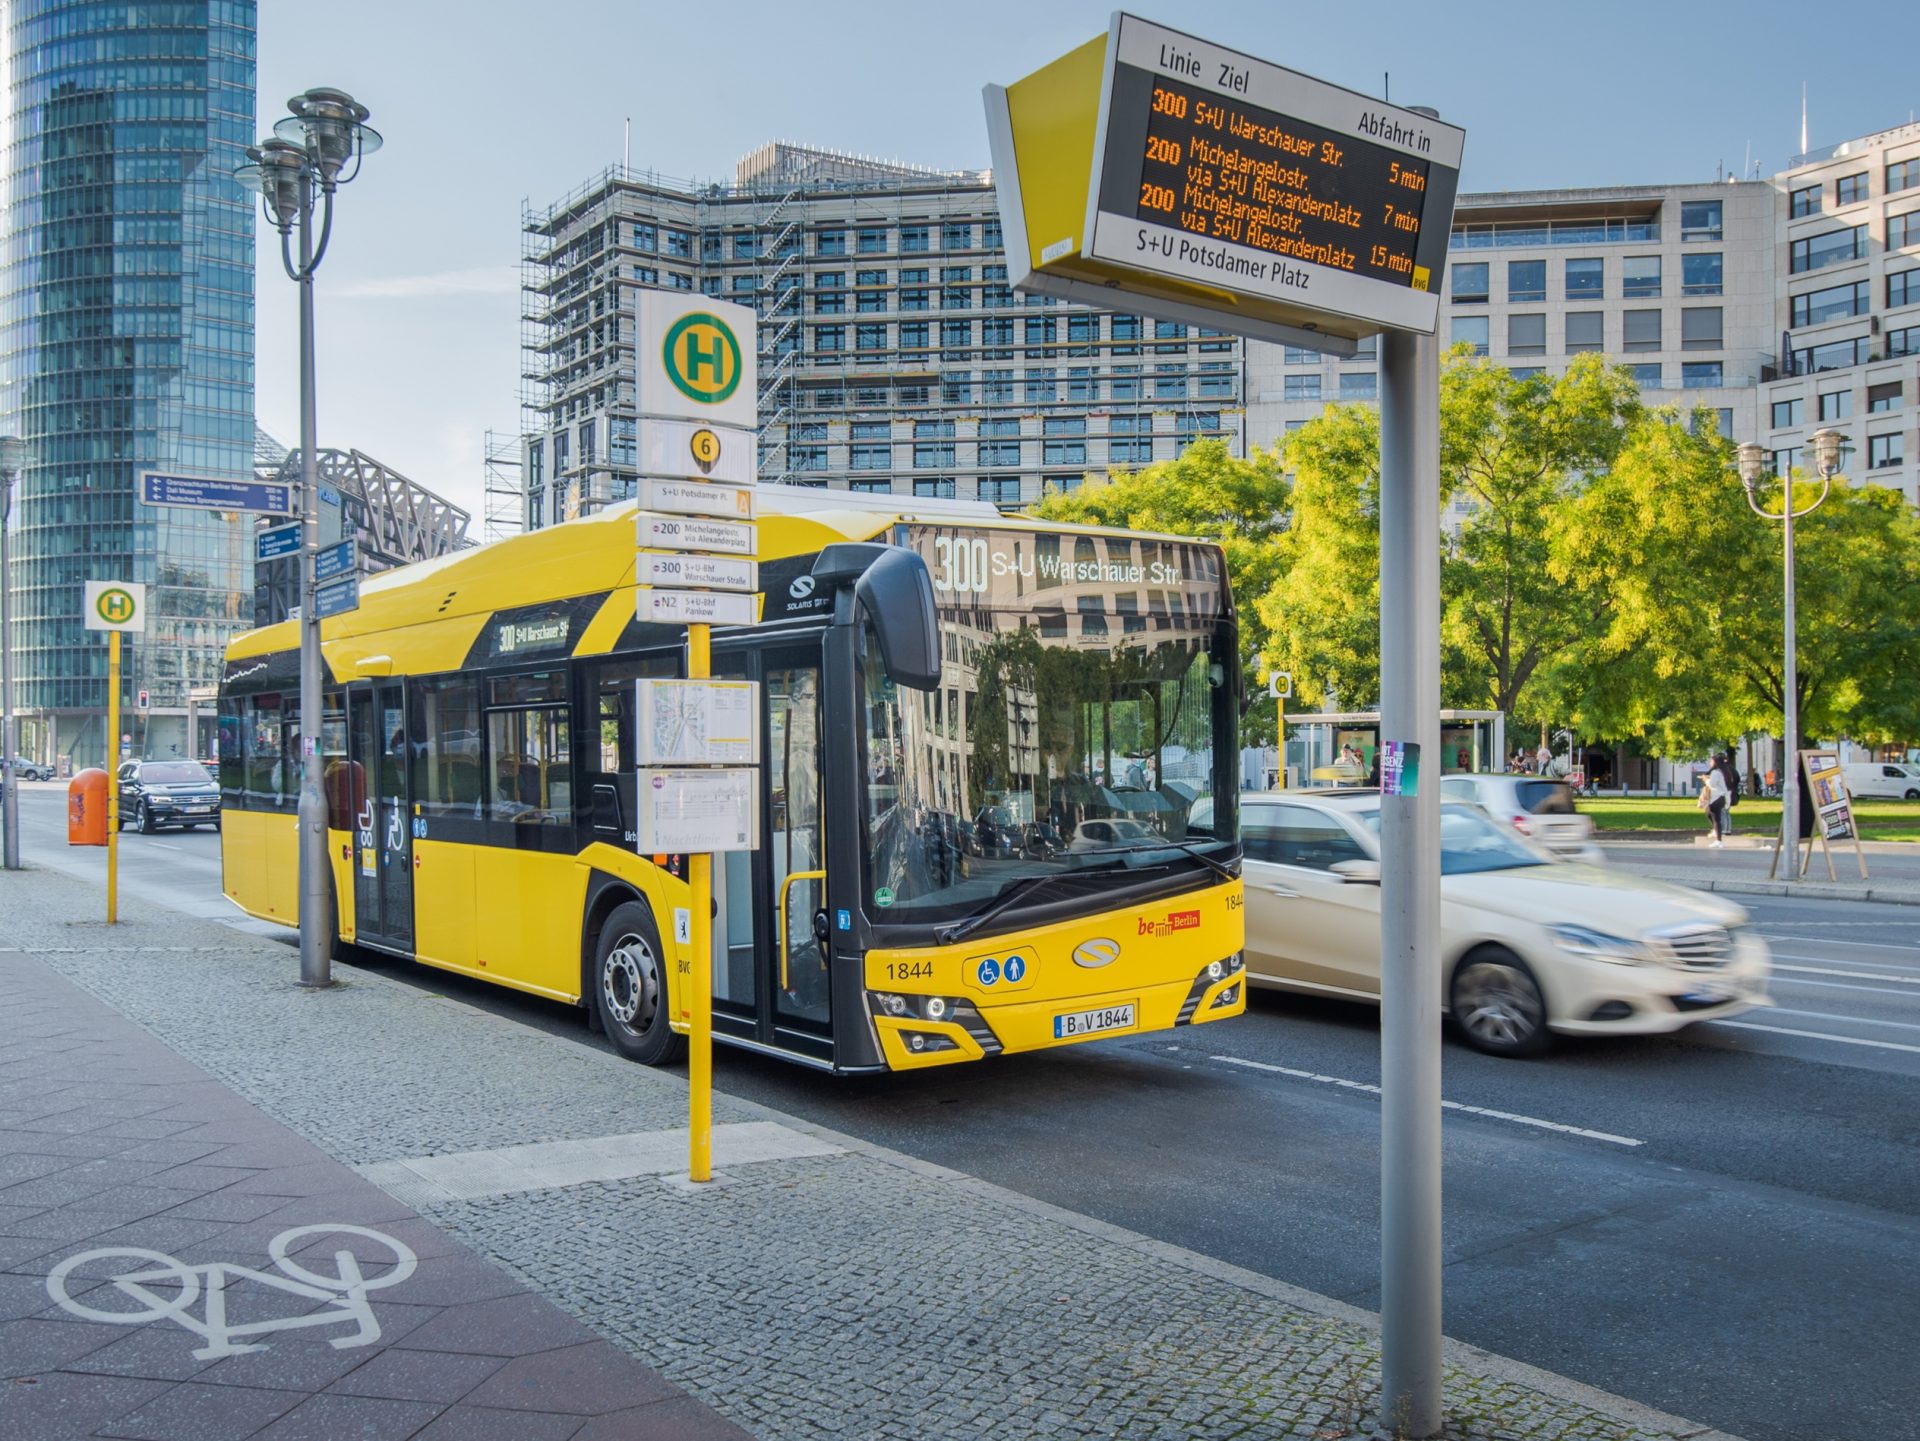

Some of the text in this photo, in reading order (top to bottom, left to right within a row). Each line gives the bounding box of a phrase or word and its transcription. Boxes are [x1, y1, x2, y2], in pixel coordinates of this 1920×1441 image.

[1160, 44, 1431, 153] Linie Ziel Abfahrt in
[1152, 88, 1426, 192] 300 S+U Warschauer Str. 5 min
[1146, 136, 1420, 233] 200 Michelangelostr. 7 min
[1187, 163, 1362, 228] via S+U Alexanderplatz
[1140, 183, 1413, 275] 200 Michelangelostr. 15 min
[1180, 209, 1356, 270] via S+U Alexanderplatz
[1136, 228, 1310, 290] S+U Potsdamer Platz
[1413, 277, 1427, 290] BVG
[687, 332, 724, 385] H
[701, 438, 711, 455] 6
[681, 488, 719, 500] Potsdamer
[660, 523, 681, 535] 200
[698, 534, 746, 548] Alexanderplatz
[661, 562, 681, 574] 300
[934, 536, 1182, 593] 300 S+U Warschauer Str.
[684, 572, 746, 586] Warschauer Straße
[106, 597, 126, 617] H
[661, 596, 677, 608] N2
[685, 606, 714, 616] Pankow
[786, 600, 812, 610] SOLARIS
[499, 624, 515, 652] 300
[528, 624, 560, 642] Warschauer
[1138, 917, 1154, 936] be
[1174, 916, 1198, 927] Berlin
[886, 962, 934, 980] 1844
[1068, 1008, 1128, 1033] B V 1844
